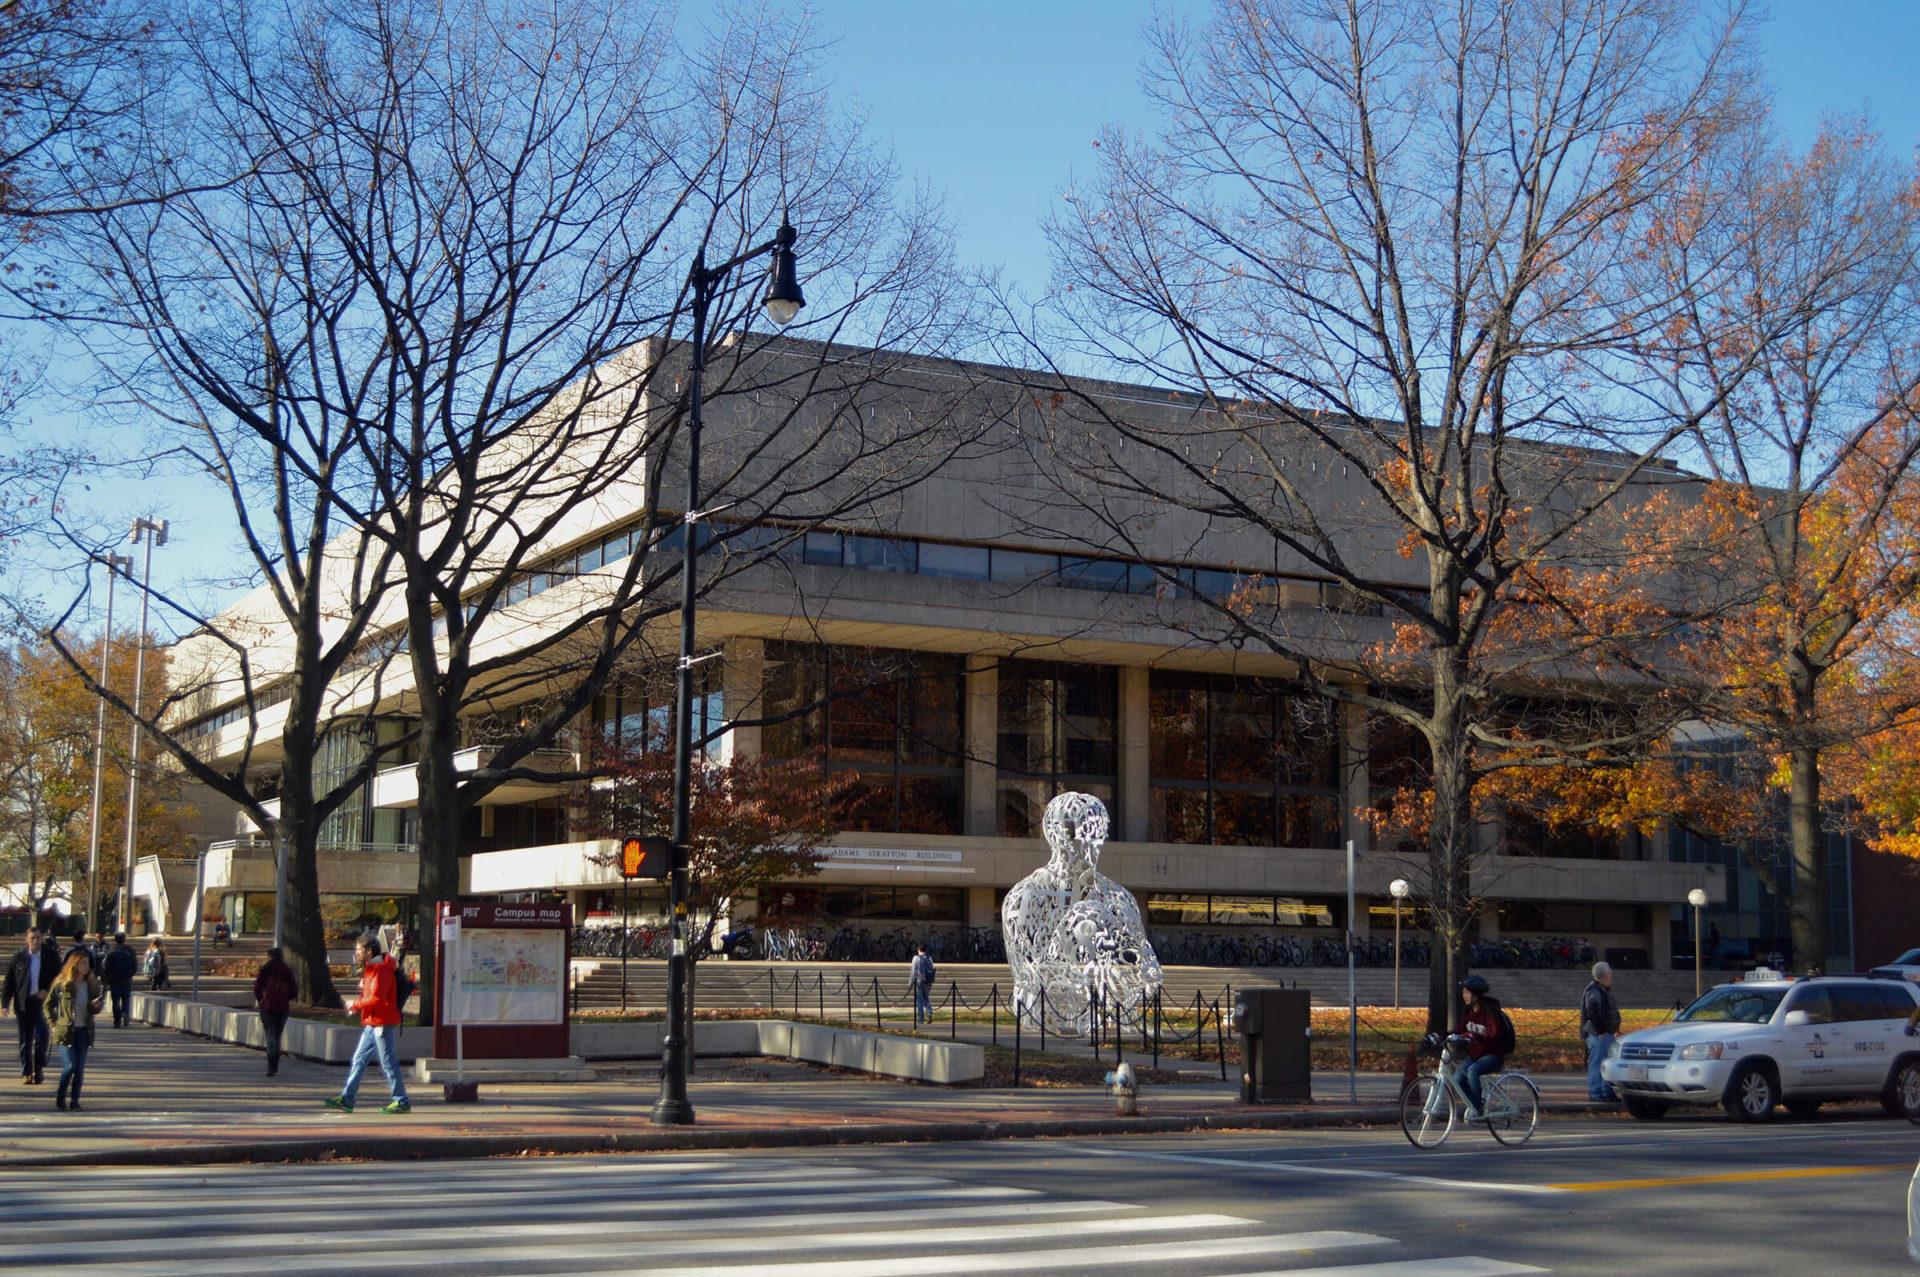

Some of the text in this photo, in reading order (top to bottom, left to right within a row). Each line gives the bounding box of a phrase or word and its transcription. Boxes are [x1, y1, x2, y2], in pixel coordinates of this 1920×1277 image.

[834, 849, 954, 860] ADAMS STRATTON BUILDING
[463, 907, 480, 917] MIT
[494, 907, 562, 919] Campus map
